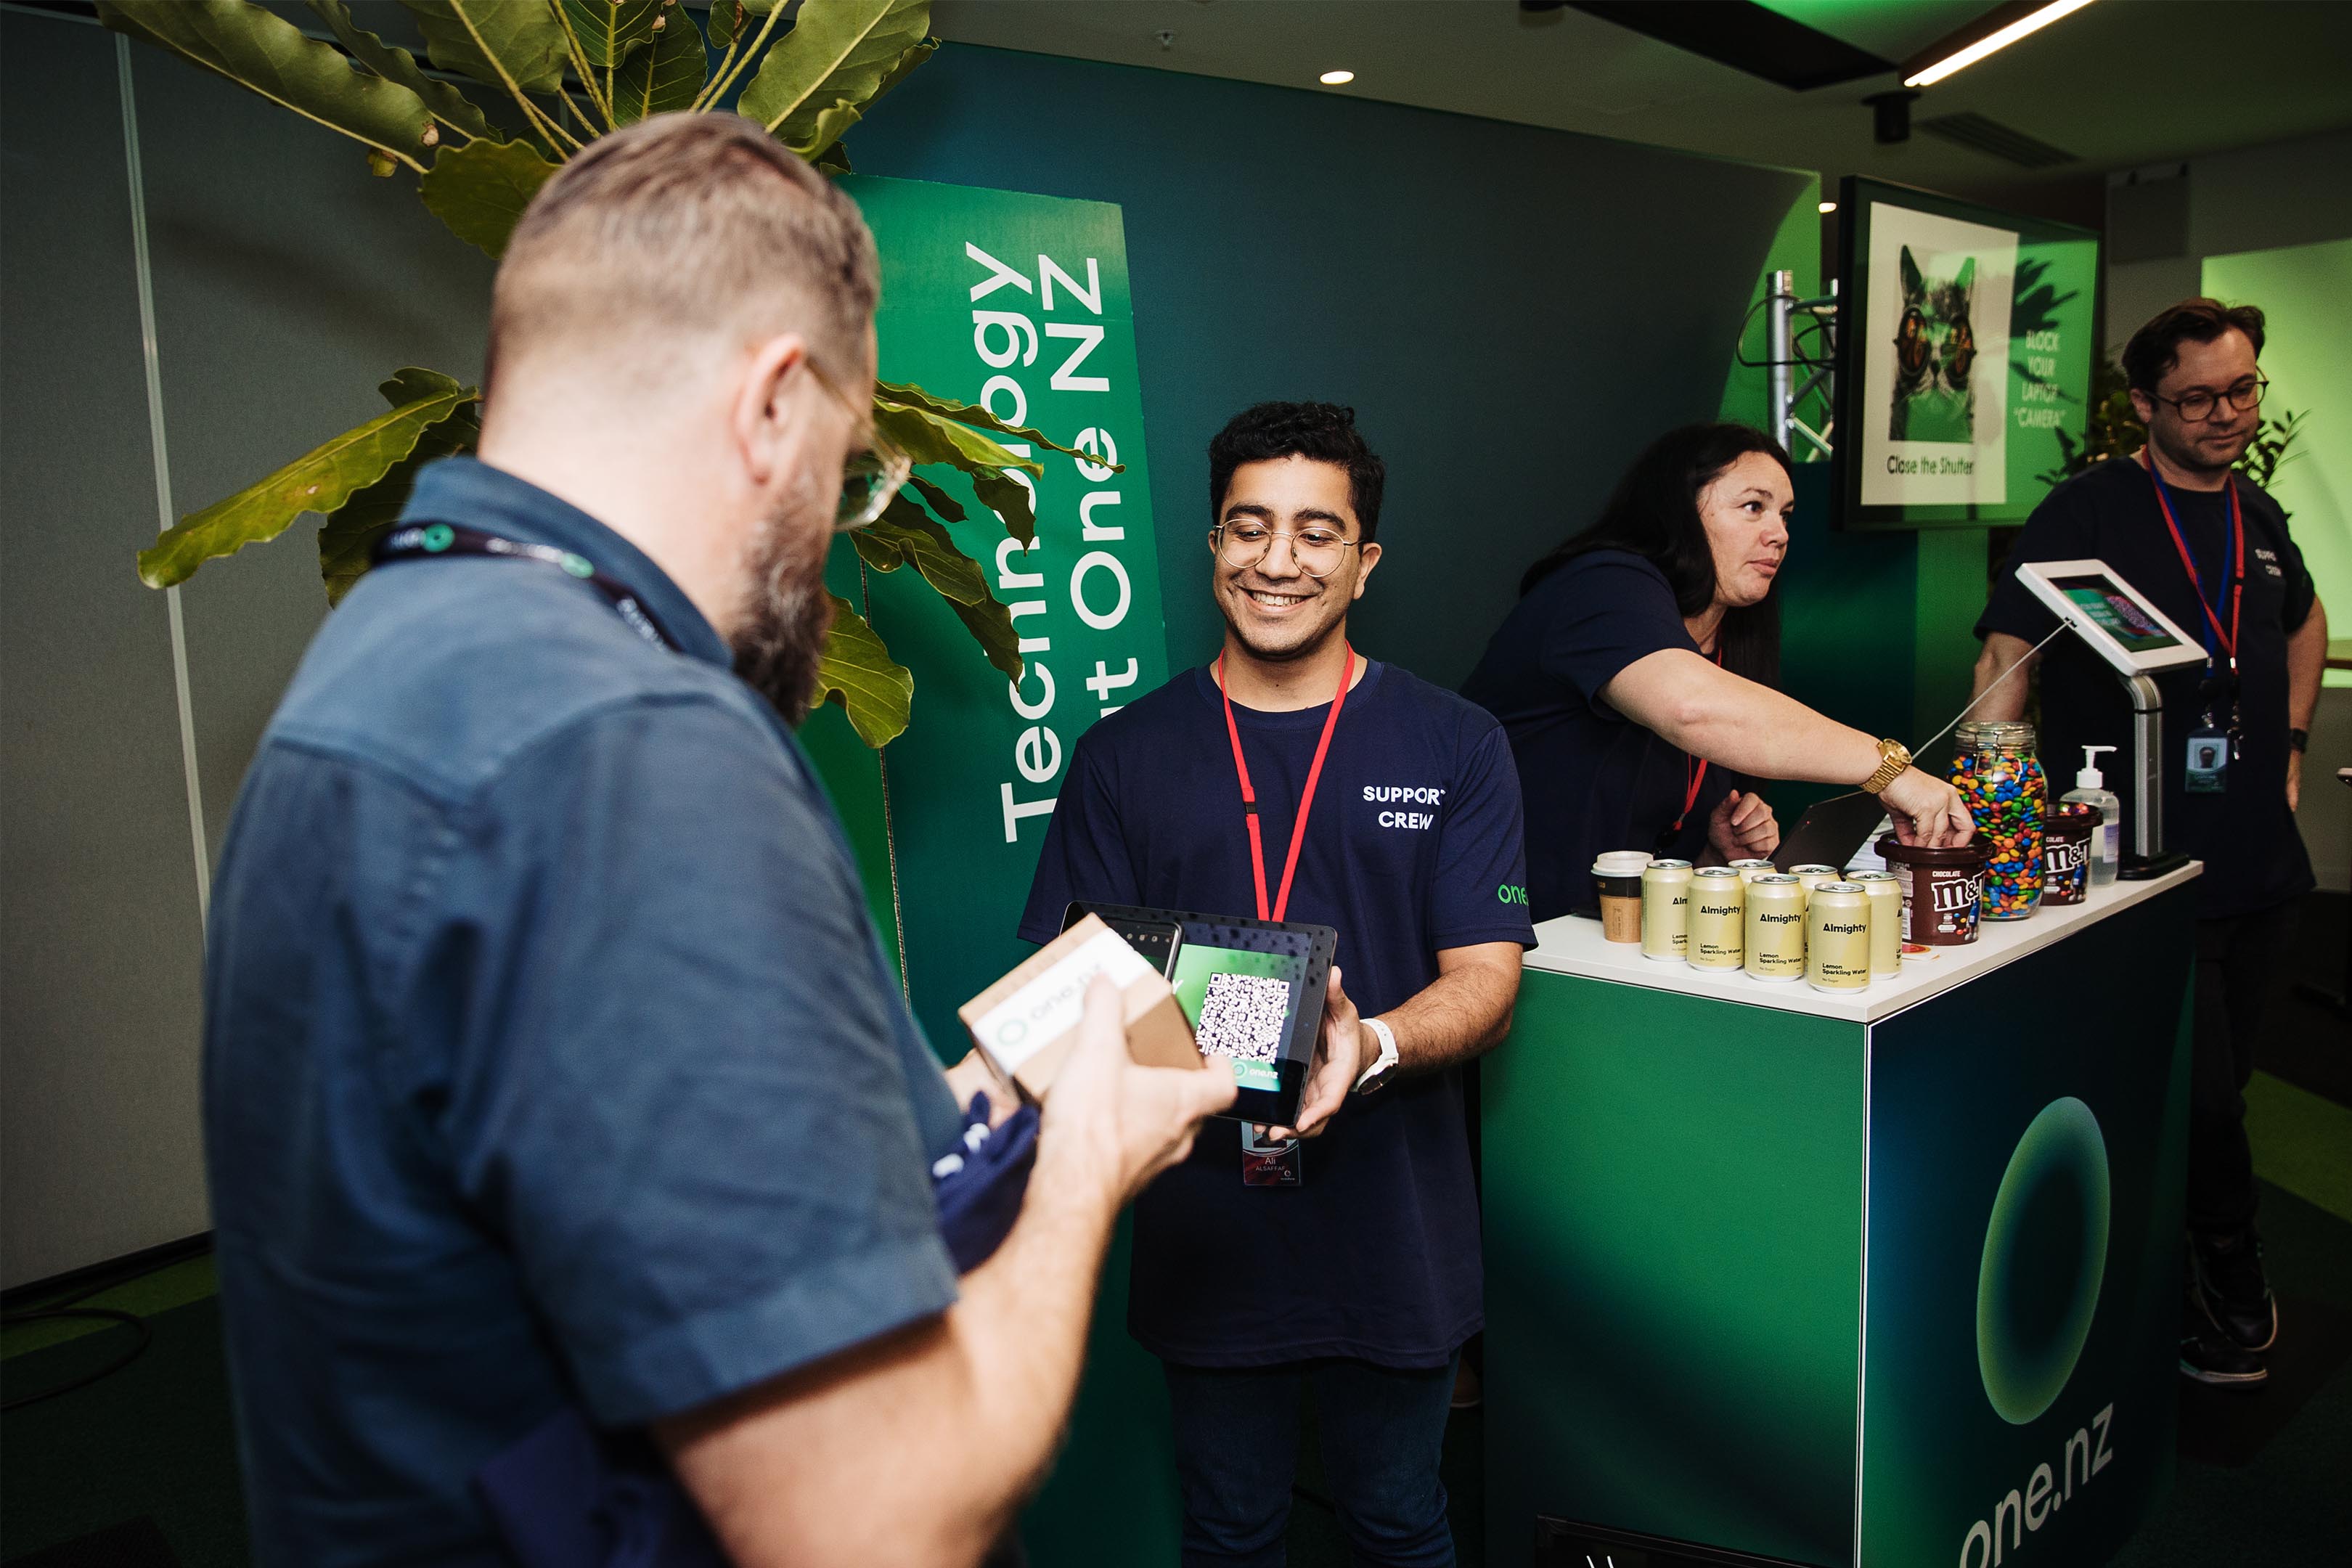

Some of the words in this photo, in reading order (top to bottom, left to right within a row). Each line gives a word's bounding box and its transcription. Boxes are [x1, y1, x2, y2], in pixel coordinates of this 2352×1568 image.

[1038, 254, 1110, 392] NZ
[2025, 330, 2059, 352] BLOCK
[2028, 356, 2056, 377] YOUR
[1887, 454, 1917, 474] Close
[1920, 456, 1937, 475] the
[1940, 456, 1973, 475] Shutter
[1070, 427, 1131, 630] One
[1379, 811, 1434, 830] CREW
[1700, 905, 1741, 916] Almighty
[1760, 913, 1802, 925] Almighty
[1823, 923, 1866, 934] Almighty
[1249, 1067, 1278, 1080] one.nz
[1265, 1156, 1276, 1165] Ali
[1959, 1402, 2114, 1568] one.nz
